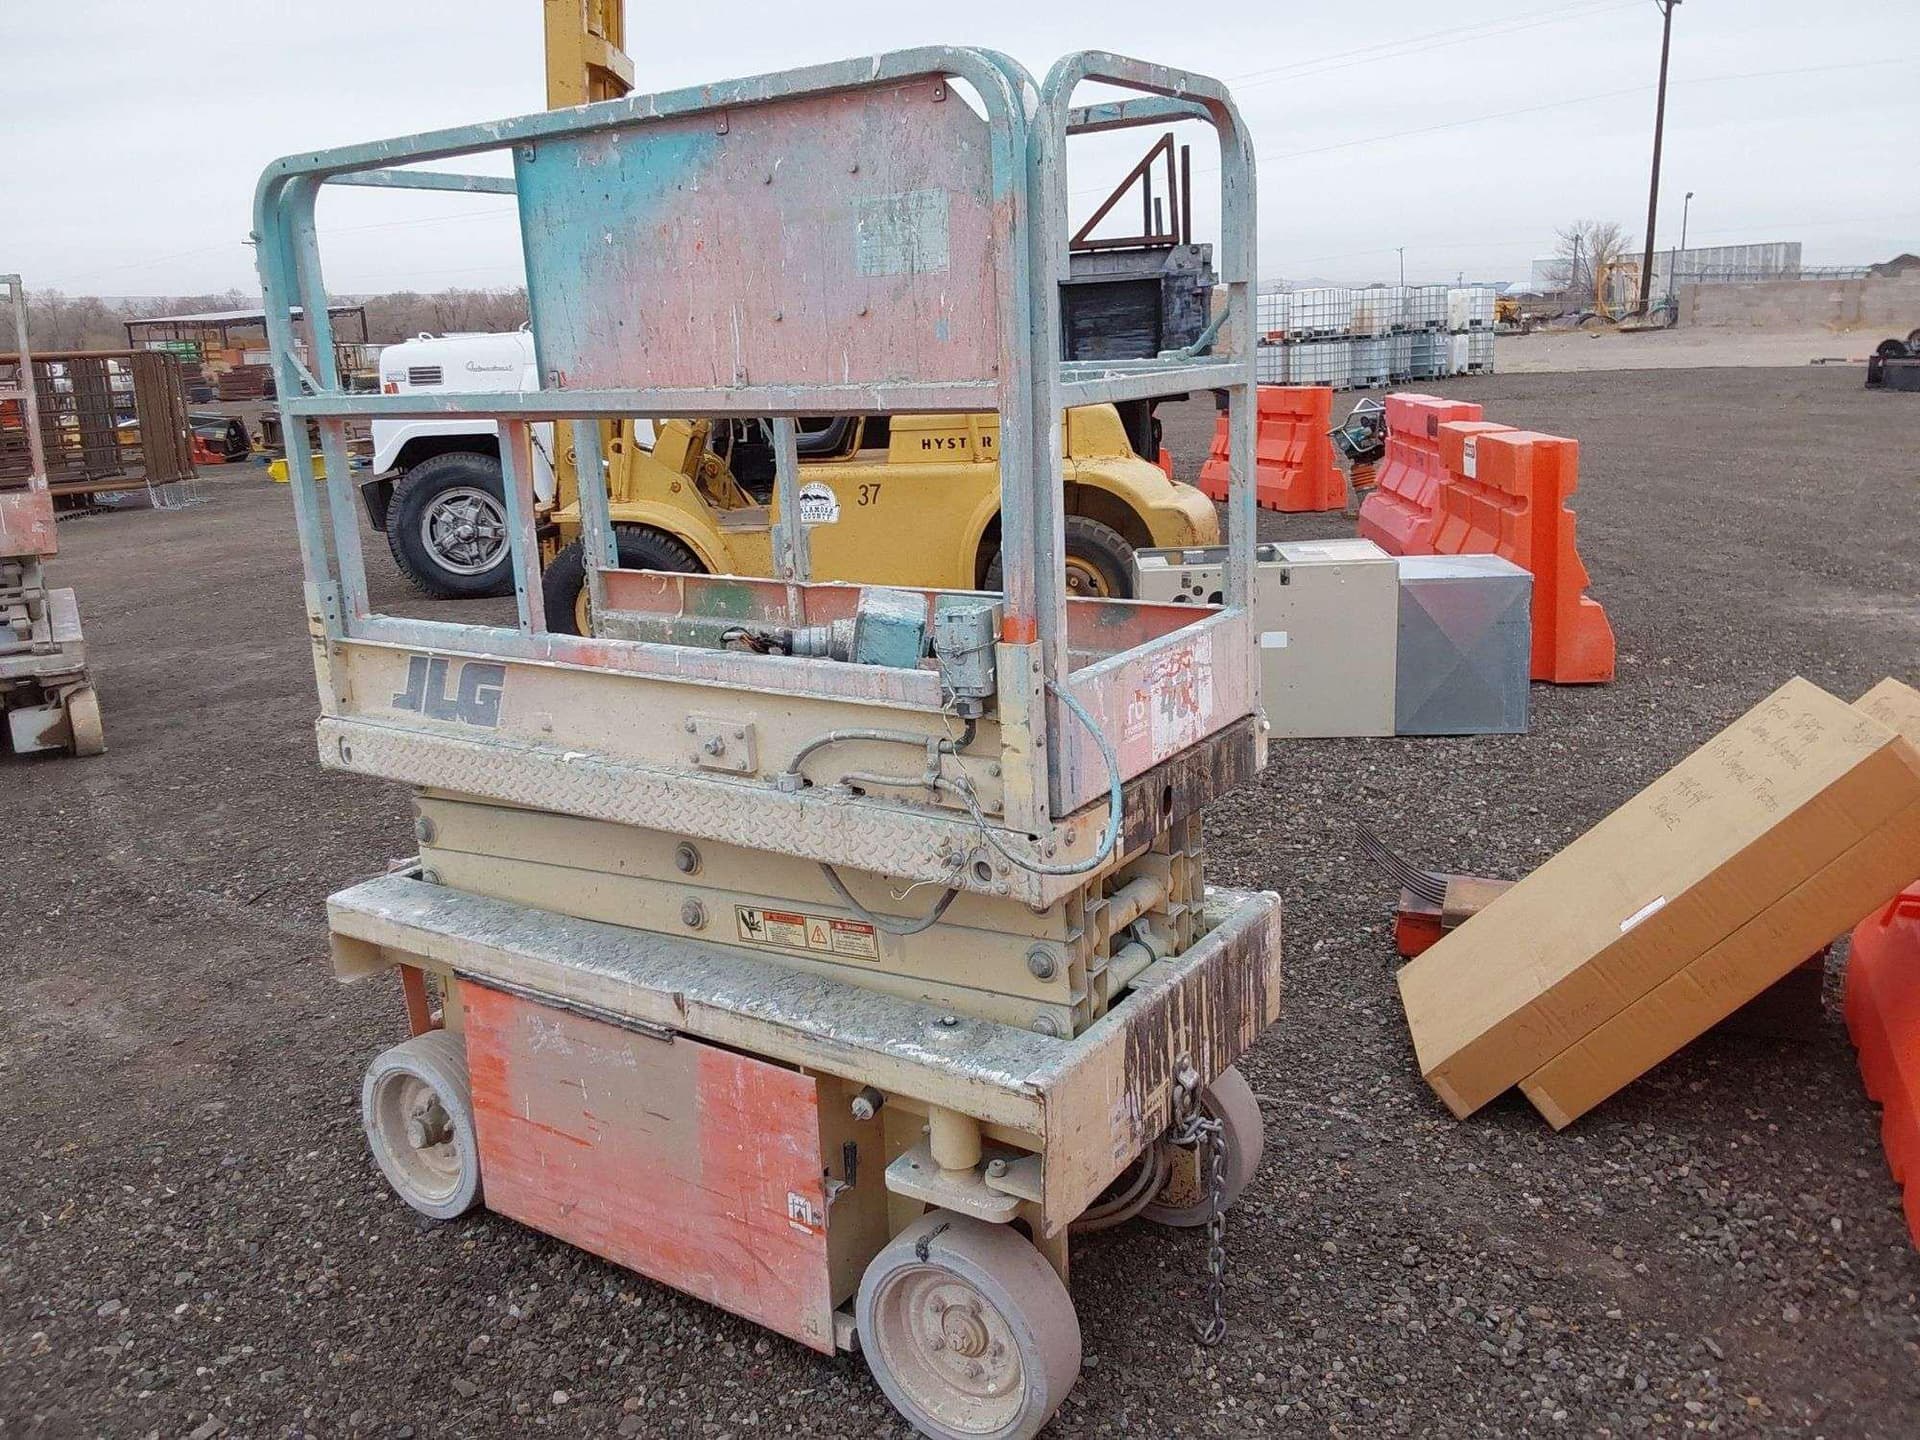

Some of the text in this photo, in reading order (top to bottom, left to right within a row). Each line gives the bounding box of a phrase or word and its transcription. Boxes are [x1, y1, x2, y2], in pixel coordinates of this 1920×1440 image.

[921, 437, 992, 450] HYSTR
[857, 483, 881, 506] 37
[391, 655, 506, 728] JLG
